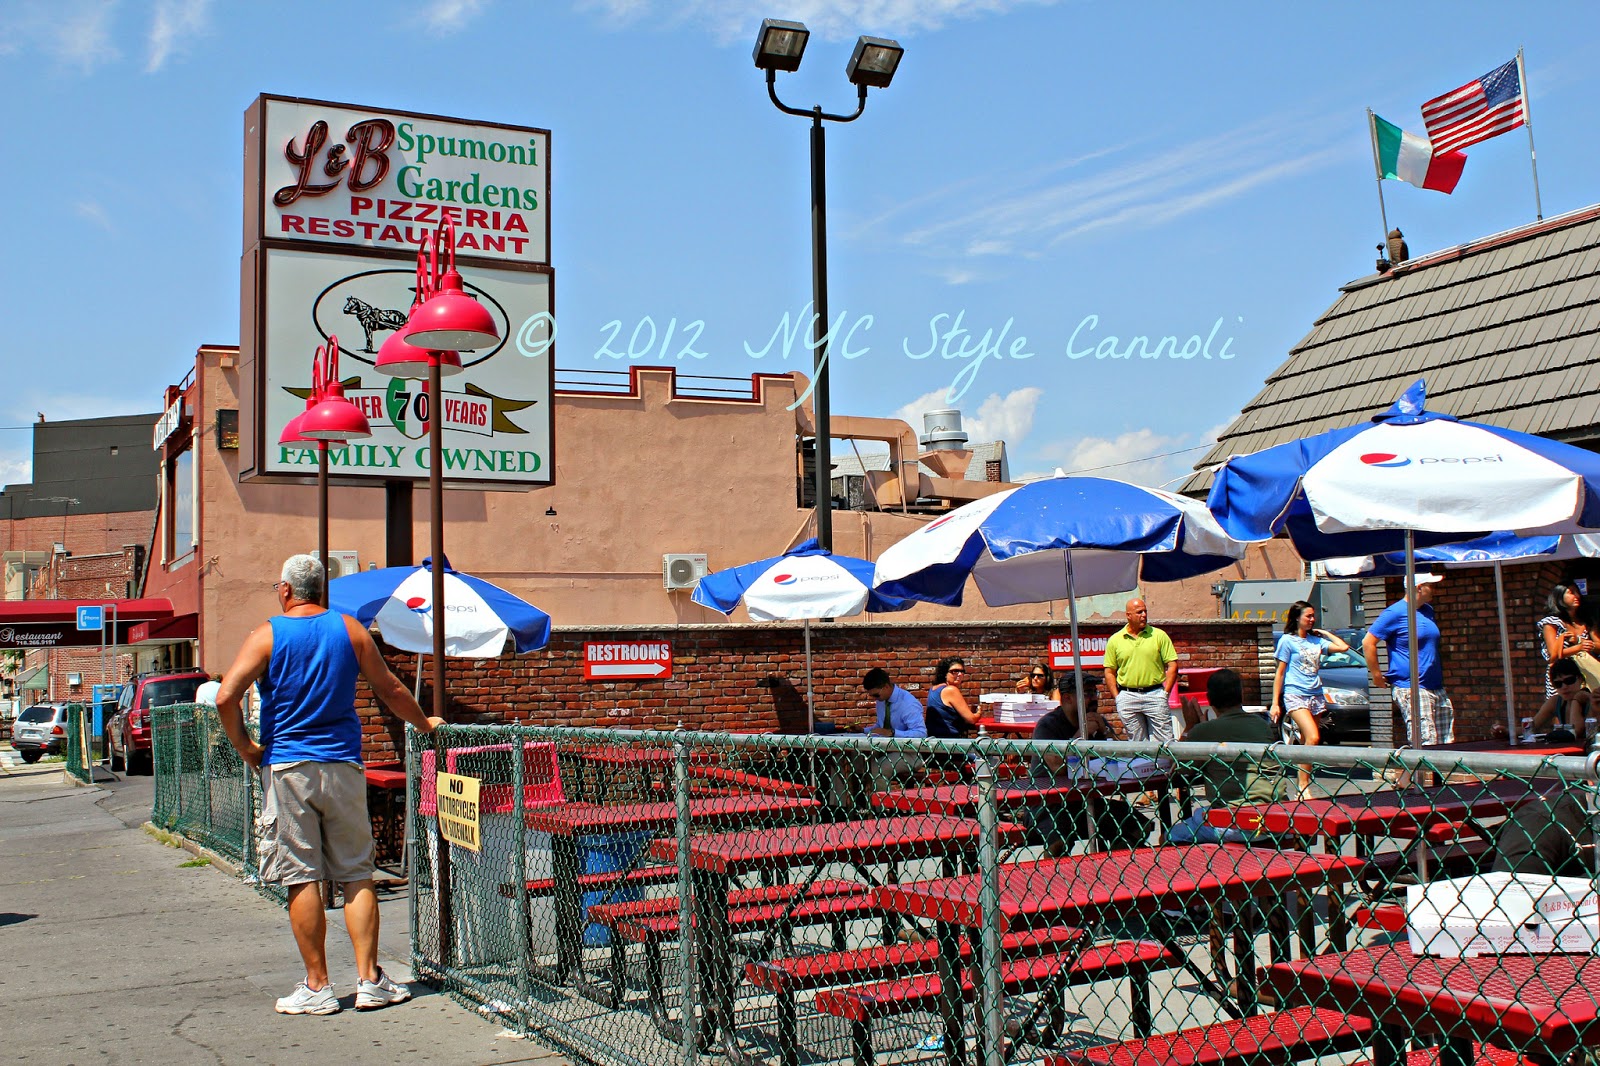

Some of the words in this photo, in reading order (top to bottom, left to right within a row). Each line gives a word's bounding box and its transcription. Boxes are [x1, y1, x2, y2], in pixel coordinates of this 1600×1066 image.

[272, 118, 396, 208] L&B
[397, 122, 539, 167] Spumoni
[396, 165, 539, 211] Gardens
[350, 196, 530, 234] PIZZERIA
[349, 395, 383, 419] ER
[393, 390, 431, 423] 70
[444, 398, 488, 427] YEARS
[278, 444, 406, 468] FAMILY
[415, 447, 542, 473] OWNED
[1419, 453, 1504, 465] pepsi
[800, 573, 840, 583] pepsi
[443, 604, 478, 614] epsi
[0, 627, 64, 643] Restaurant
[587, 643, 670, 662] RESTROOMS
[1050, 637, 1110, 653] RESROOM
[449, 778, 463, 794] NO
